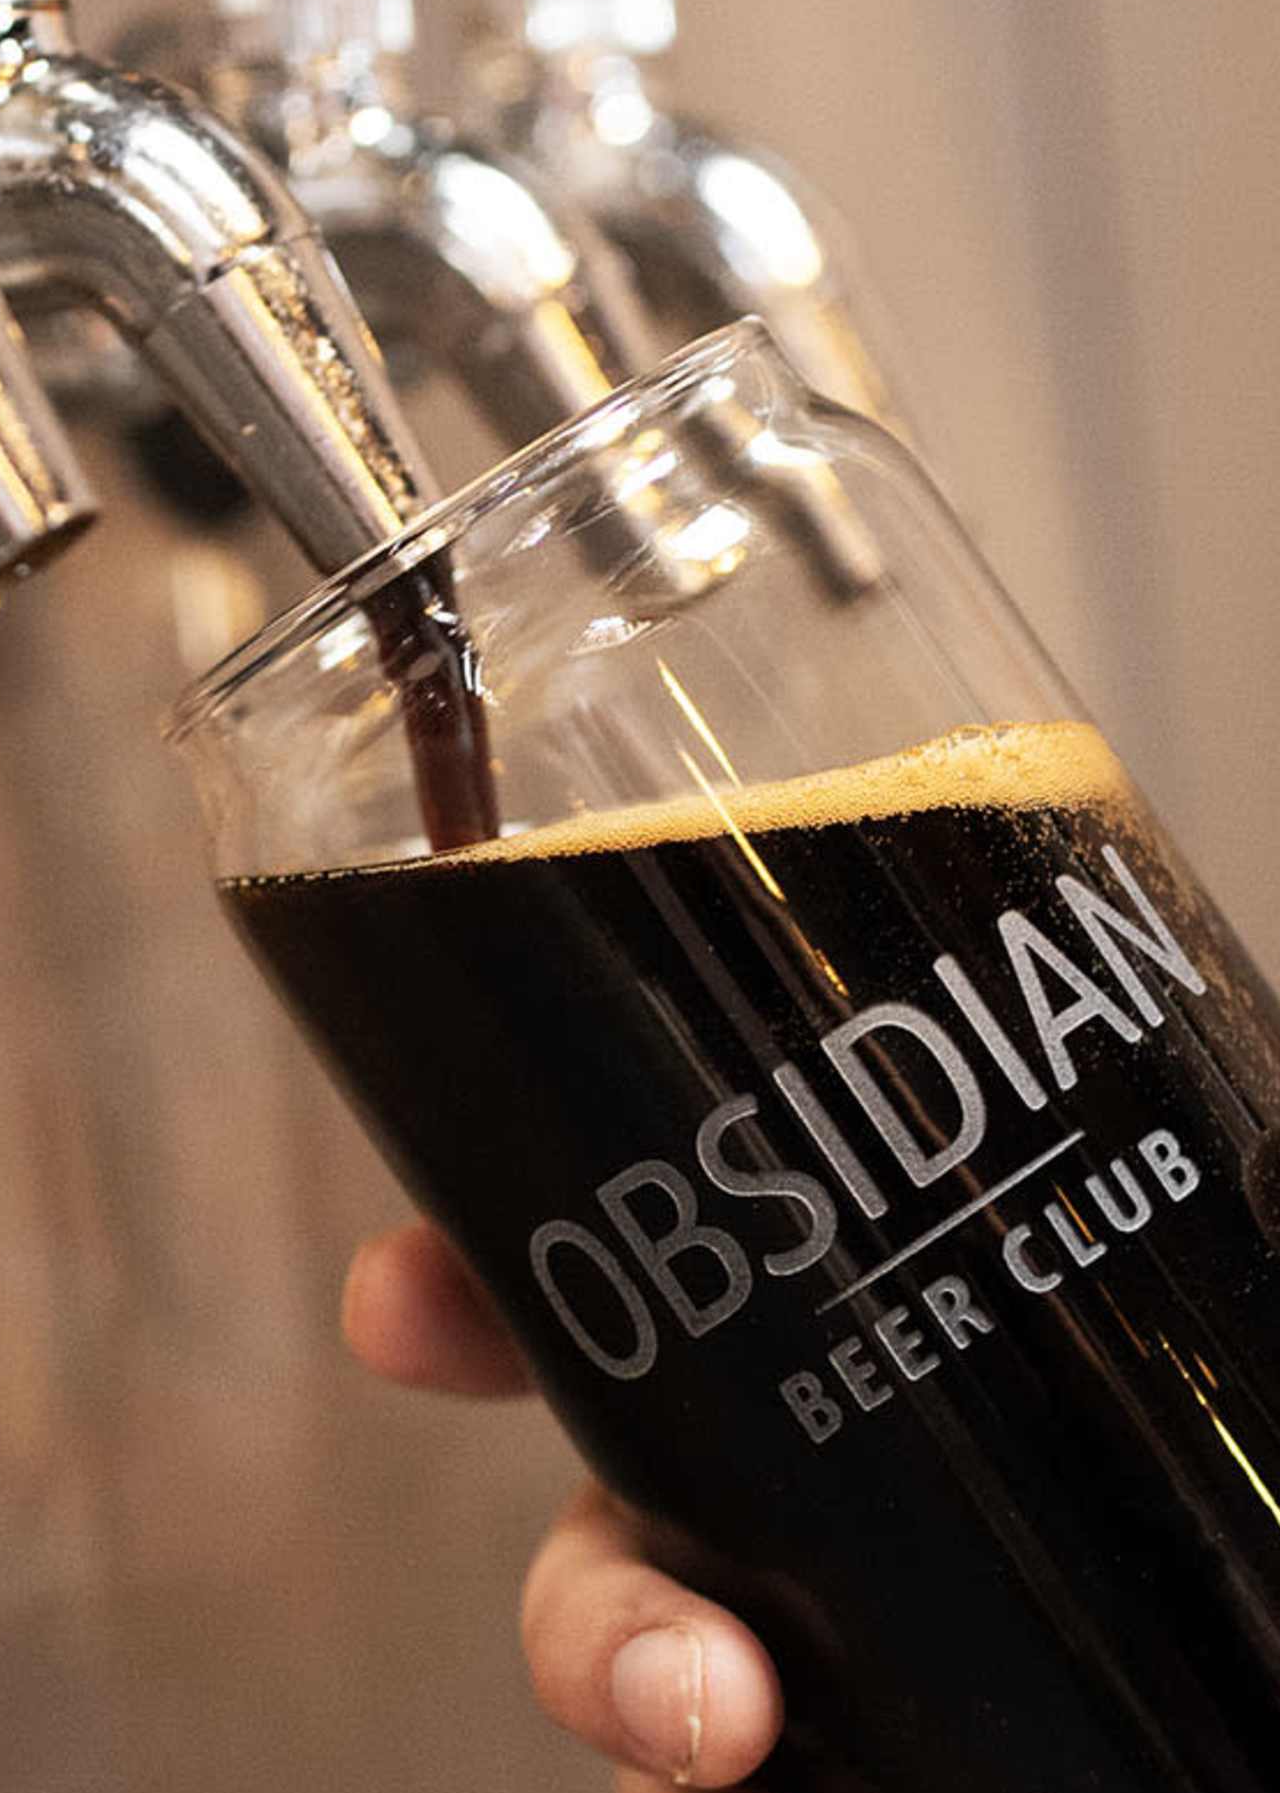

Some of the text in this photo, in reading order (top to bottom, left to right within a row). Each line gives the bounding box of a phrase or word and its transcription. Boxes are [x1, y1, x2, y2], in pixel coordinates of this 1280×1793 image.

[529, 844, 1206, 1380] OBSIDIAN
[779, 1129, 1202, 1444] BEER CLUB
